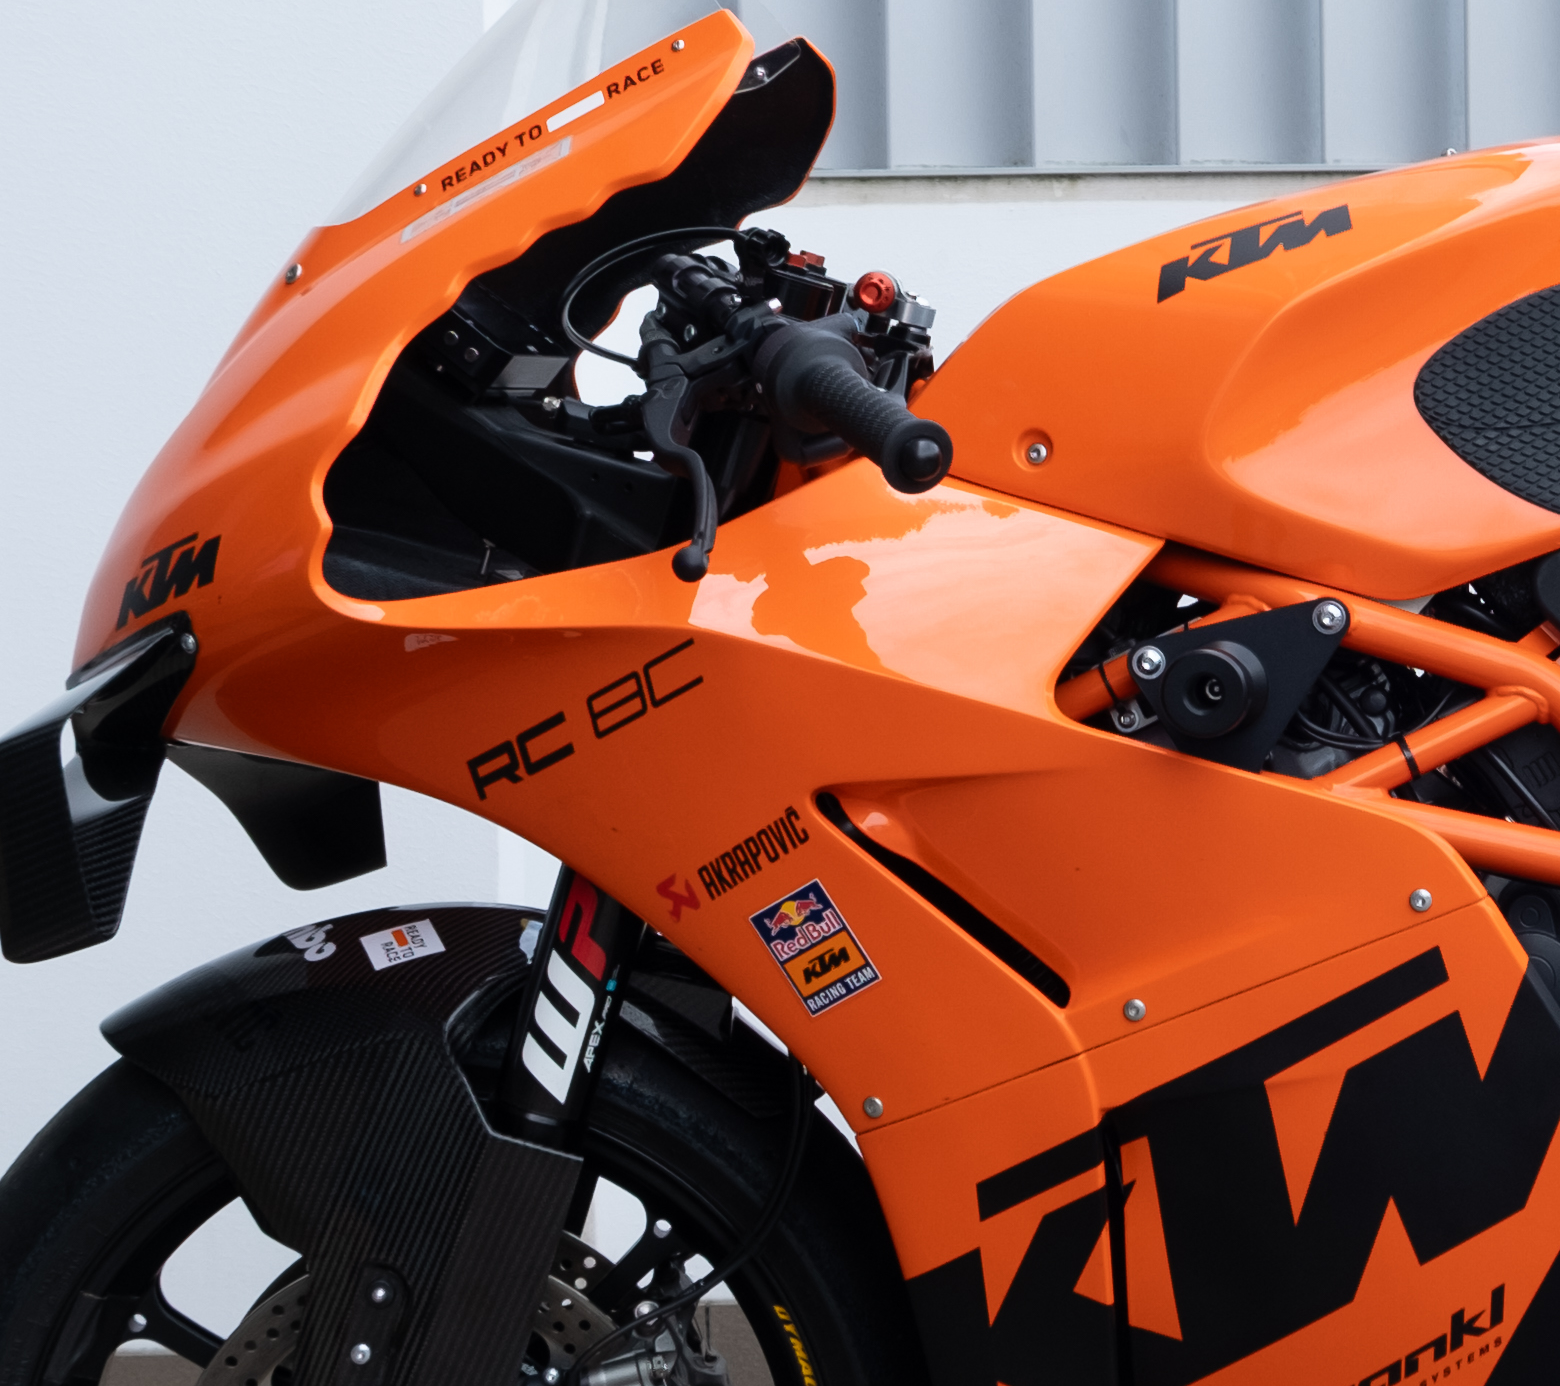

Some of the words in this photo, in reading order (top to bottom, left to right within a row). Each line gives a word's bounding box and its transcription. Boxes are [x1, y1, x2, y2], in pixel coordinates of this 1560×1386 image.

[440, 142, 508, 192] READY
[515, 124, 543, 149] TO
[606, 58, 665, 99] RACE
[1157, 203, 1353, 304] KTM
[116, 531, 222, 632] KTM
[467, 710, 575, 801] RC
[586, 638, 704, 739] 8C
[381, 941, 401, 963] RACE
[400, 947, 415, 959] TO
[404, 925, 427, 949] READY
[770, 925, 808, 962] Red
[807, 908, 842, 943] Bull
[802, 946, 850, 984] KTM
[807, 982, 847, 1012] RACING
[845, 966, 875, 992] TEAM
[583, 1019, 605, 1073] APEX
